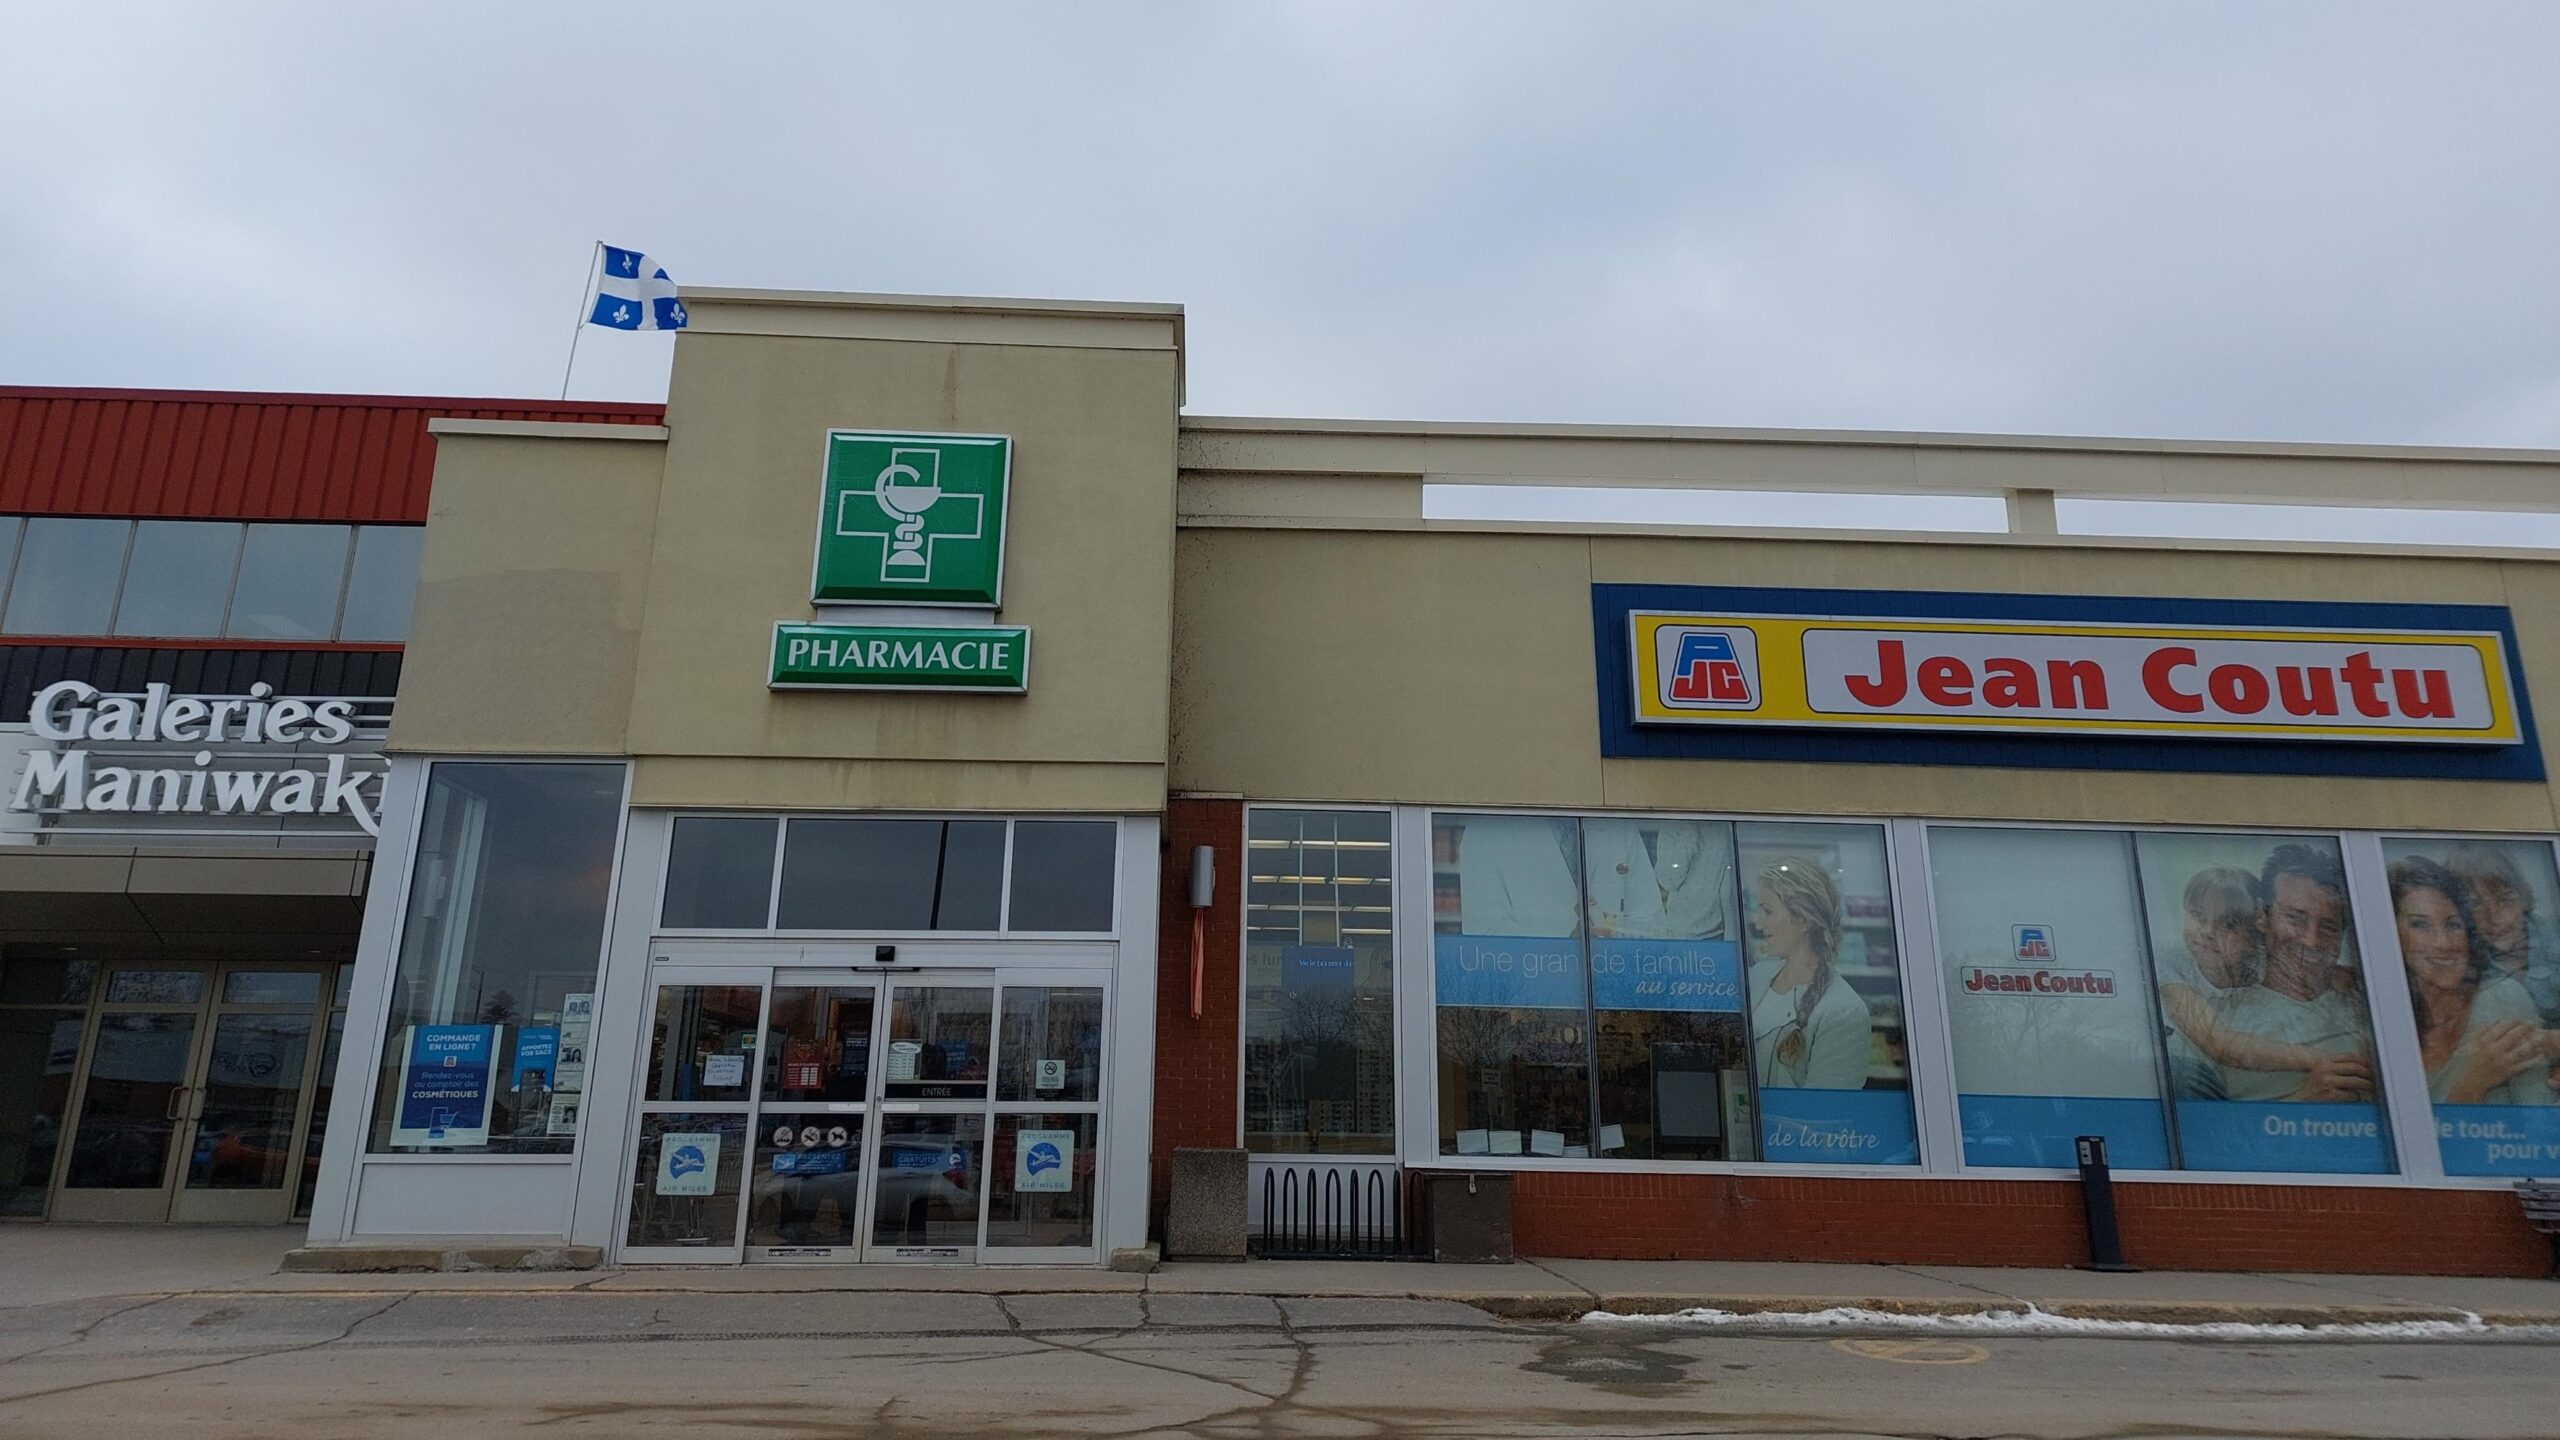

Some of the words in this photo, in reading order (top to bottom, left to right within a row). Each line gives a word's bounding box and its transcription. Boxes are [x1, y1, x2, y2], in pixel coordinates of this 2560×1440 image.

[788, 638, 1010, 670] PHARMACIE
[1845, 640, 2109, 709] Jean
[2142, 646, 2456, 719] Coutu
[29, 680, 356, 744] Galeries
[1459, 946, 1513, 972] Une
[1634, 948, 1716, 977] famille
[1636, 980, 1665, 994] au
[1669, 976, 1738, 996] service
[1966, 969, 2032, 992] Jean
[2034, 971, 2114, 994] Coutu
[426, 1034, 481, 1042] COMMANDE
[428, 1043, 442, 1051] EN
[412, 1089, 479, 1099] COSMÉTIQUES
[921, 1085, 952, 1097] ENTRÉE
[1768, 1124, 1795, 1146] de
[1799, 1125, 1822, 1147] la
[1827, 1128, 1880, 1148] vôtre
[2264, 1115, 2297, 1136] On
[2302, 1117, 2377, 1137] trouve
[2488, 1143, 2541, 1165] pour
